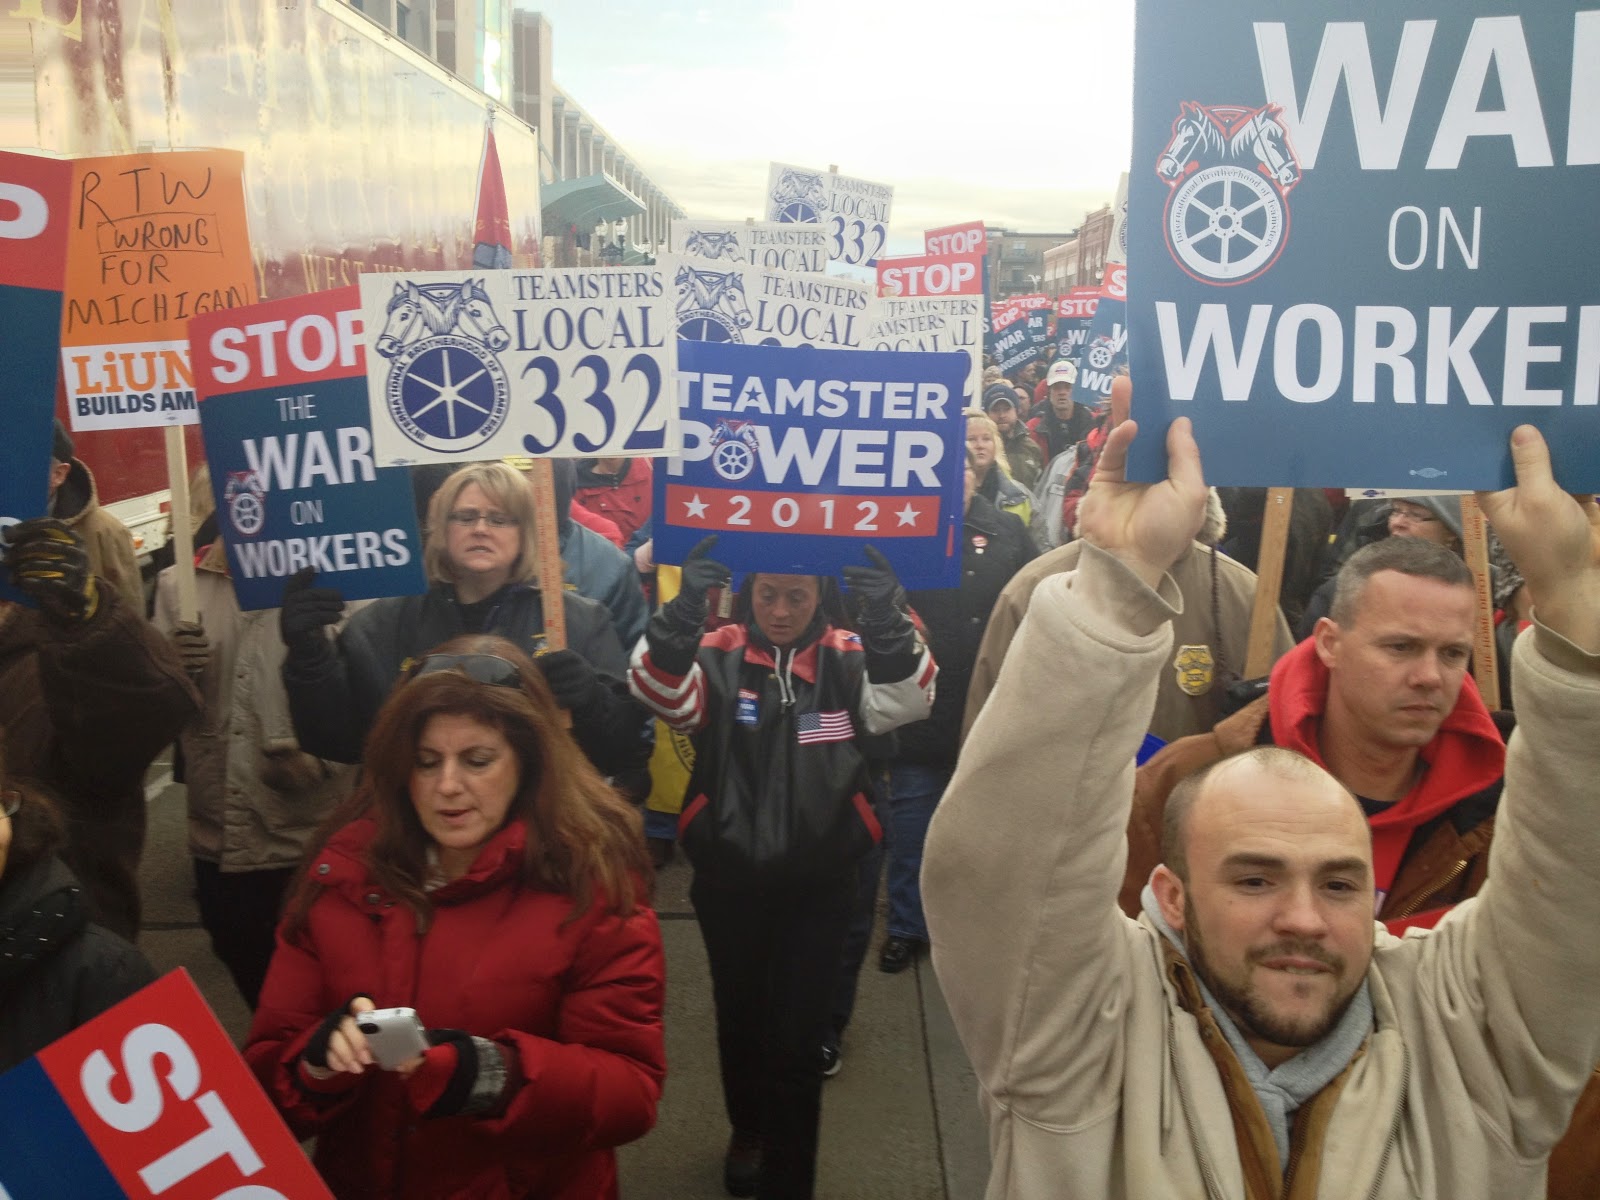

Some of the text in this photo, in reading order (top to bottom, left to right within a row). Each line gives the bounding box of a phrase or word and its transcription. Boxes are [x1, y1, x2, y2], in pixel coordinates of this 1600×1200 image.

[1253, 10, 1600, 170] WA
[79, 166, 212, 230] RTW
[831, 176, 893, 198] TEAMSTERS
[828, 191, 889, 224] LOCAL
[1199, 168, 1261, 189] Brotherhood
[1265, 199, 1277, 247] Teamsters
[113, 218, 208, 249] WRONG
[751, 230, 826, 246] TEAMSTERS
[828, 214, 886, 268] 332
[927, 229, 982, 255] STOP
[1388, 205, 1482, 271] ON
[101, 254, 171, 285] FOR
[749, 248, 824, 273] LOCAL
[513, 271, 664, 300] TEAMSTERS
[763, 275, 868, 311] TEAMSTERS
[882, 262, 976, 296] STOP
[67, 284, 249, 334] MICHIGAN
[755, 300, 860, 348] LOCAL
[884, 300, 978, 317] TEAMSTERS
[514, 306, 665, 351] LOCAL
[994, 330, 1025, 352] WAR
[407, 337, 488, 359] BROTHERHOOD
[1155, 301, 1600, 406] WORKE
[76, 395, 157, 416] BUILDS
[275, 395, 317, 421] THE
[520, 354, 667, 454] 332
[672, 371, 949, 419] TEAMSTER
[242, 426, 377, 492] WAR
[290, 500, 324, 526] ON
[726, 495, 879, 531] 2012
[233, 529, 411, 578] WORKERS
[1478, 573, 1489, 610] DEPOT
[80, 1023, 292, 1200] ST
